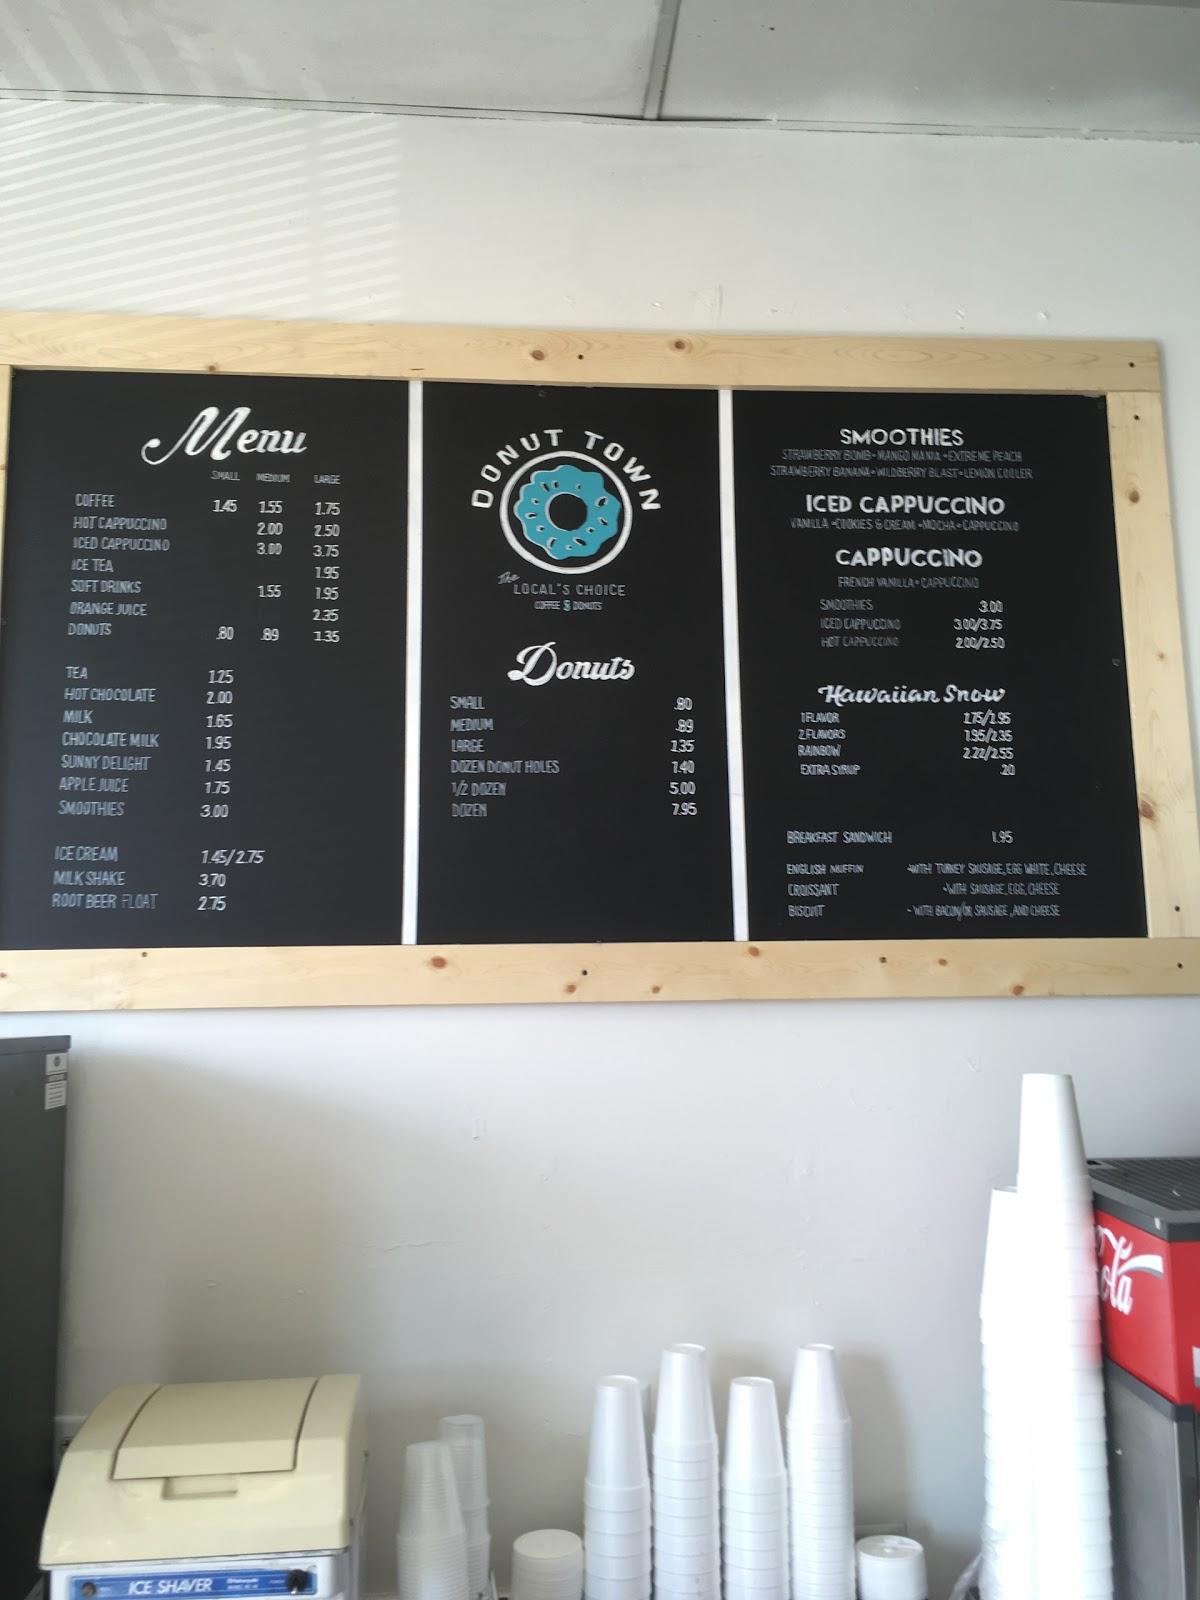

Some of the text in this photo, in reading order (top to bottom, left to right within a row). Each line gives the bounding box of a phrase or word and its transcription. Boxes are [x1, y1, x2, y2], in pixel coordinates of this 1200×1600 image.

[141, 406, 307, 465] Menu
[840, 428, 964, 447] SMOOTHIES
[211, 470, 240, 481] SMALL
[314, 475, 341, 484] LARGE
[472, 429, 661, 511] DONUT TOWN
[75, 494, 114, 507] COFFEE
[259, 501, 282, 513] 1.55
[315, 502, 340, 515] 1.75
[806, 495, 1005, 515] ICED CAPPUCCINO
[74, 516, 340, 537] HOT CAPPUCCINO 2.00 2.50
[74, 537, 339, 558] ICED CAPPUCCINO 3.00 3.75
[835, 548, 983, 567] CAPPUCCINO
[72, 559, 339, 579] ICE TEA 1.95
[71, 580, 339, 600] SOFT DRINKS 1.55 1.95
[576, 584, 626, 596] CHOICE
[70, 602, 339, 622] ORANGE JUICE 2.35
[820, 599, 1003, 613] SMOOTHIES 3.00
[68, 623, 111, 635] DONUTS
[314, 630, 340, 643] 1.35
[821, 637, 840, 647] HOT
[507, 641, 635, 686] Donuts
[66, 667, 233, 684] TEA 1.25
[64, 688, 233, 704] HOT CHOCOLATE 2.00
[450, 696, 485, 709] SMALL
[817, 684, 1006, 706] Hawaiian Snow
[63, 710, 233, 728] MILK 1.65
[450, 719, 493, 731] MEDIUM
[62, 732, 231, 750] CHOCOLATE MILK 1.95
[451, 739, 695, 752] LARGE 1.35
[798, 744, 841, 757] RAINBOW
[61, 755, 231, 772] SUNNY DELIGHT 1.45
[451, 760, 485, 773] DOZEN
[487, 760, 522, 773] DONUT
[524, 760, 559, 773] HOLES
[800, 764, 832, 775] EXTRA
[60, 778, 230, 794] APPLE JUICE 1.75
[452, 781, 696, 796] 1/2 DOZEN 5.00
[58, 801, 229, 818] SMOOTHIES 3.00
[452, 803, 697, 817] DOZEN 7.95
[786, 831, 1013, 843] BREAKFAST SANDWICH 1.95
[54, 846, 265, 866] ICE CREAM 1.45/2.75
[786, 863, 826, 875] ENGLISH
[829, 863, 864, 874] MUFFIN
[54, 871, 226, 887] MILK SHAKE 3.70
[788, 884, 839, 896] CROISSANT
[52, 893, 226, 911] ROOT BEER FLOAT 2.75
[788, 904, 825, 917] BISCUIT
[129, 1581, 152, 1595] ICE
[157, 1578, 213, 1594] SHAVER
